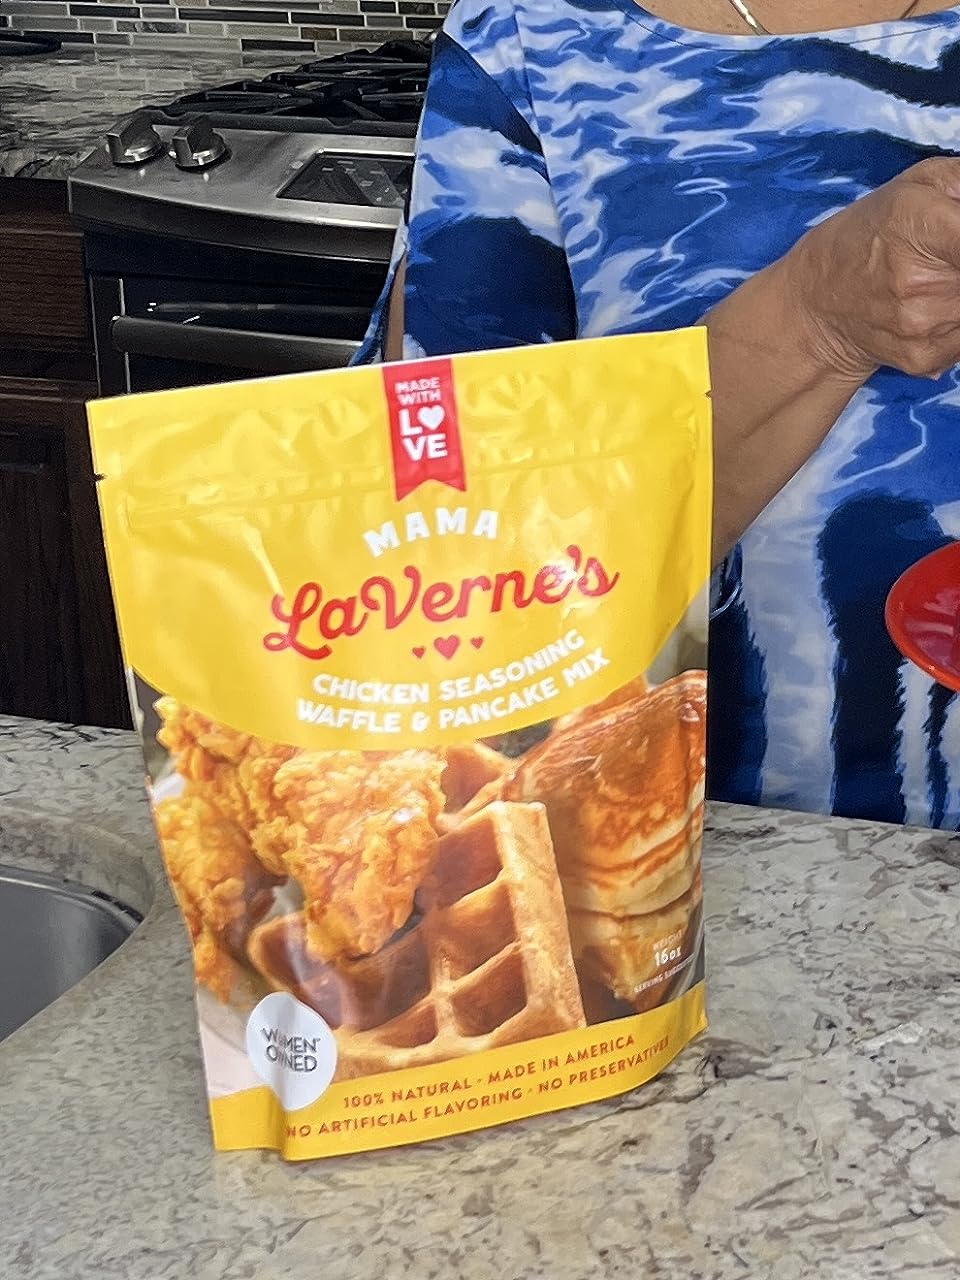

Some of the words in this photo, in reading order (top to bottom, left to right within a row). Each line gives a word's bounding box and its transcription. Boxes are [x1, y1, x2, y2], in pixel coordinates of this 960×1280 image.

[395, 377, 440, 394] MADE
[397, 389, 442, 406] WITH
[362, 506, 499, 558] MAMA
[263, 544, 620, 660] LaVerne's
[296, 698, 402, 734] WAFFLE
[411, 712, 429, 733] &
[438, 678, 560, 730] PANCAKE
[562, 648, 612, 688] MIX
[311, 672, 430, 705] CHICKEN
[438, 629, 586, 700] SEASONING
[286, 1125, 312, 1138] NO
[318, 1110, 418, 1135] ARTIFICIAL
[423, 1087, 523, 1119] FLAVORING
[538, 1078, 563, 1094] NO
[568, 1035, 669, 1086] PRESERVATIVES
[343, 1092, 384, 1108] 100%
[391, 1078, 472, 1103] NATURAL
[488, 1061, 537, 1084] MADE
[542, 1056, 559, 1072] IN
[565, 1034, 635, 1064] AMERICA
